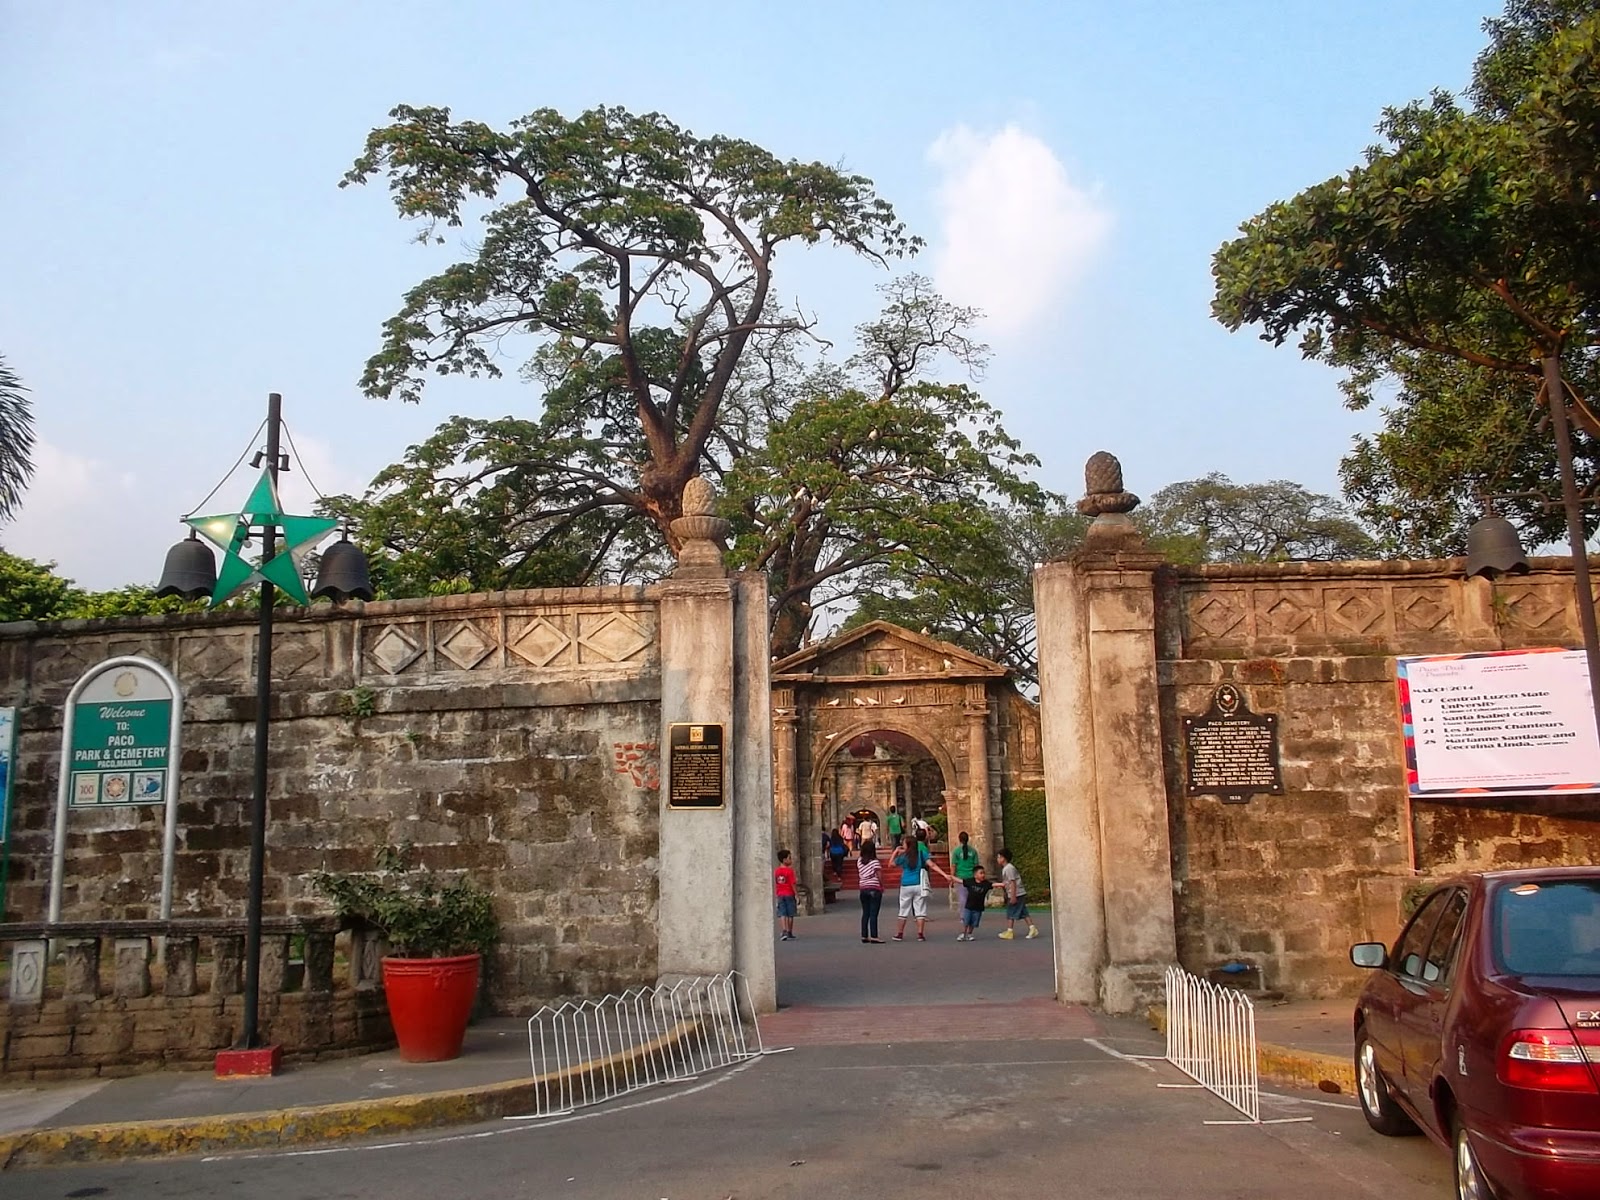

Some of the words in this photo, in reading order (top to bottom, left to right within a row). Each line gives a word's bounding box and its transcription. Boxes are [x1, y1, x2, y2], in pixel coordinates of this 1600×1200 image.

[1440, 695, 1481, 703] Central
[1441, 701, 1496, 709] University
[99, 706, 146, 719] Welcome
[116, 722, 130, 731] TO:
[1504, 722, 1564, 730] Chanteurs
[108, 735, 135, 747] PACO
[1445, 736, 1499, 744] Marianne
[75, 749, 101, 761] PARK
[103, 749, 111, 760] &
[113, 747, 167, 759] CEMETERY
[1576, 1010, 1600, 1020] EX
